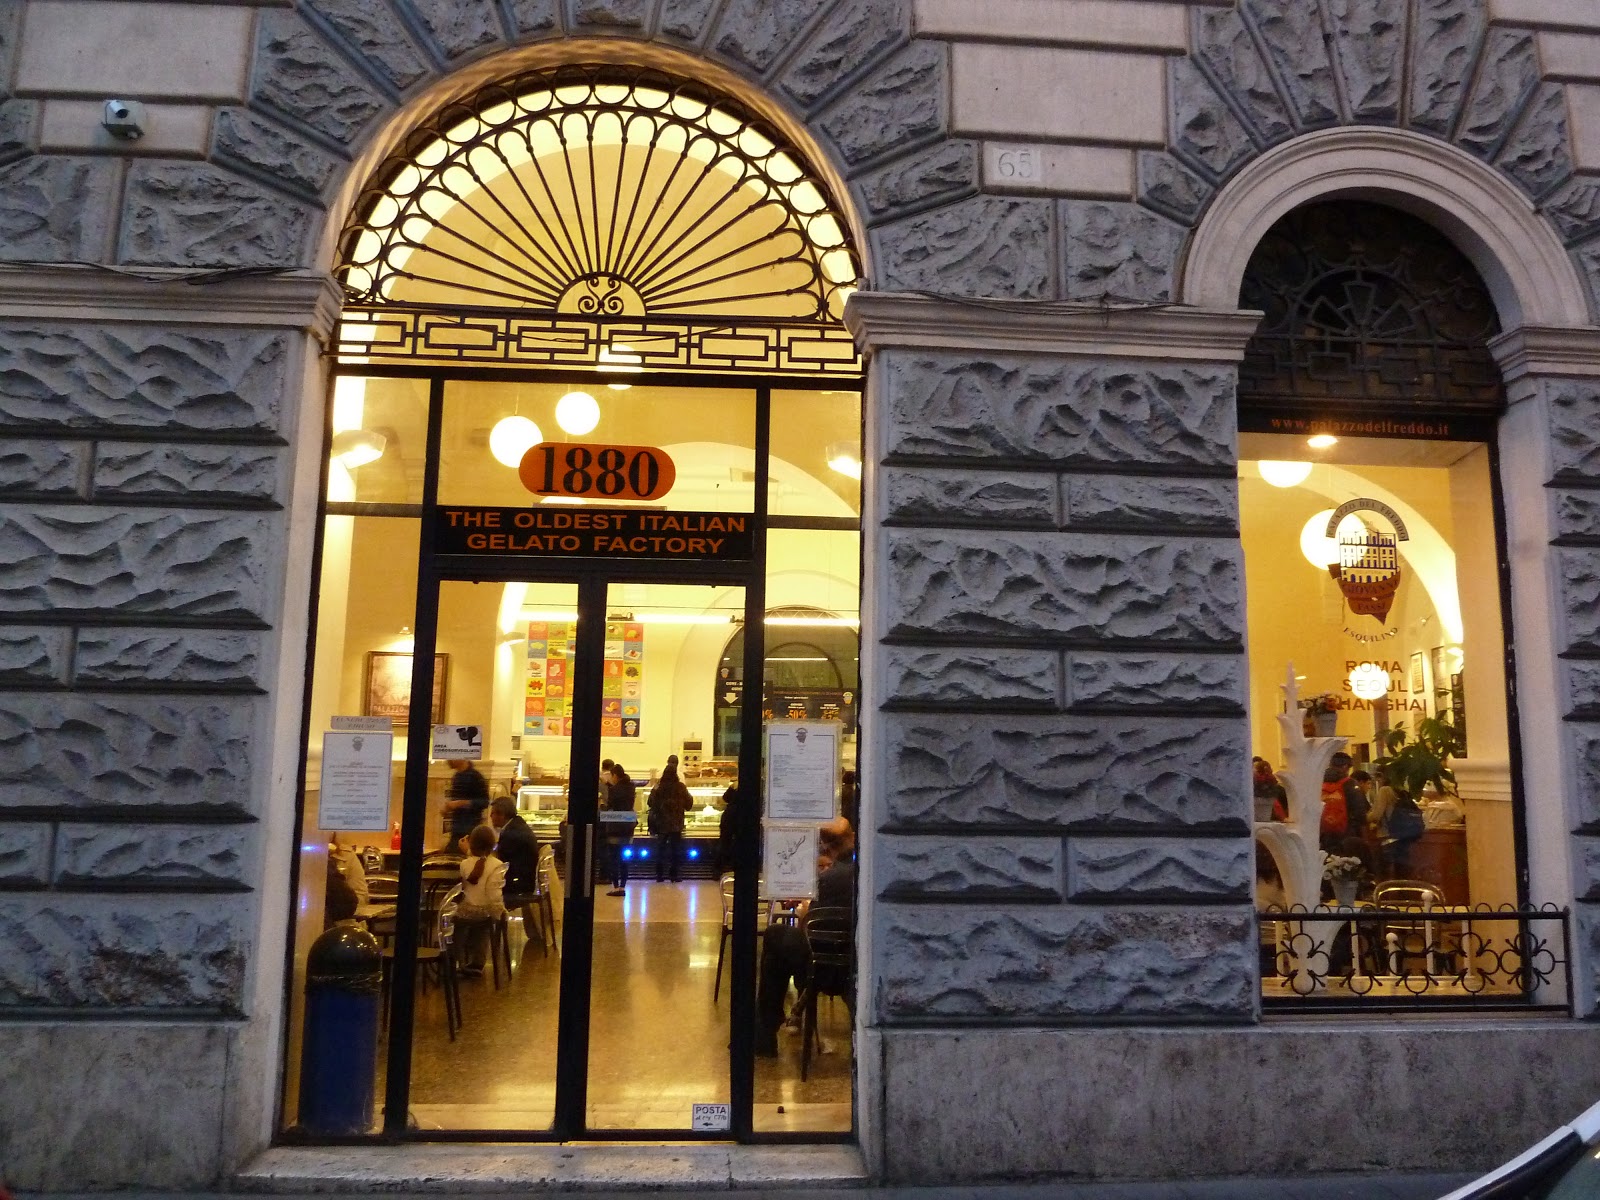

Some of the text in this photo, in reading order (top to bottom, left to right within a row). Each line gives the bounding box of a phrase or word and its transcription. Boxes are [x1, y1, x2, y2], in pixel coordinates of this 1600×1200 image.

[999, 152, 1032, 178] 65
[536, 446, 659, 497] 1880
[446, 511, 745, 533] THE OLDEST ITALIAN
[1327, 503, 1356, 536] PALAZZO
[1380, 506, 1406, 540] FREDDO
[466, 533, 725, 554] GELATO FACTORY
[1343, 626, 1399, 643] ESQUILINO
[1345, 660, 1404, 674] ROMA
[1342, 679, 1409, 693] SEOUL
[695, 1106, 726, 1114] POSTA
